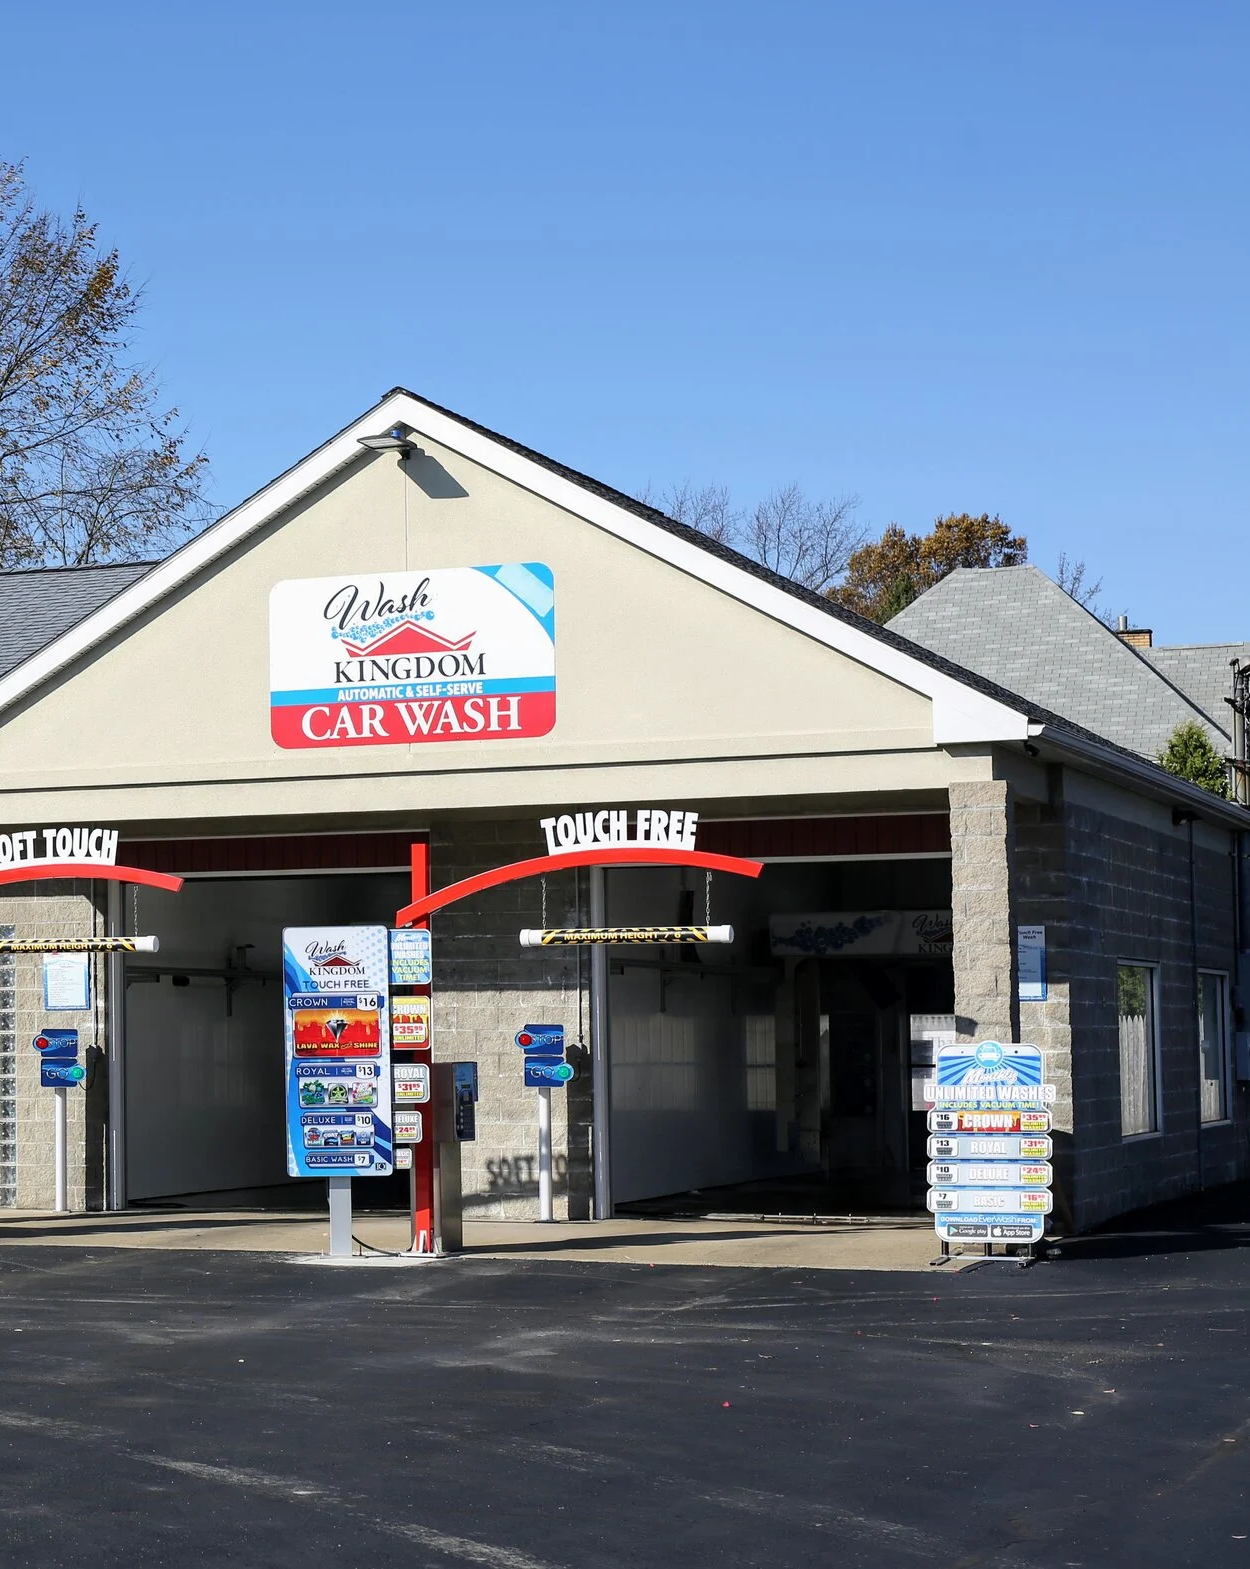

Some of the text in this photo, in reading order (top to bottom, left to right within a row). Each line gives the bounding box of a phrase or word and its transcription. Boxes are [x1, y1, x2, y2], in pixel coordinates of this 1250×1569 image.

[323, 577, 431, 630] Wash
[334, 653, 486, 683] KINGDOM
[338, 681, 483, 702] AUTOMATIC & SELF-SERVE
[302, 696, 522, 740] CAR WASH
[540, 810, 699, 847] TOUCH FREE
[43, 828, 118, 858] TOUCH
[912, 912, 950, 932] Was
[564, 932, 620, 941] MAXIMUM
[620, 931, 658, 940] HEIGHT
[11, 943, 59, 951] MAXIMUM
[305, 940, 345, 957] Wash
[918, 944, 952, 953] KING
[310, 966, 365, 975] KINGDOM
[303, 980, 369, 989] TOUCH FREE
[289, 998, 328, 1007] CROWN
[359, 997, 376, 1007] $16
[46, 1068, 68, 1079] GO
[296, 1067, 330, 1075] ROYAL
[358, 1066, 373, 1076] $13
[394, 1068, 425, 1078] ROYAL
[530, 1066, 555, 1079] GO
[926, 1086, 1054, 1101] UNLIMITED WASHES
[980, 1101, 1015, 1109] VACUUM
[357, 1116, 371, 1124] $10
[963, 1114, 1013, 1128] CROWN
[970, 1141, 1007, 1154] ROYAL
[358, 1156, 366, 1164] $7
[969, 1168, 1009, 1180] DELUXE
[974, 1195, 1005, 1207] BASIC
[978, 1215, 1017, 1223] EverWash
